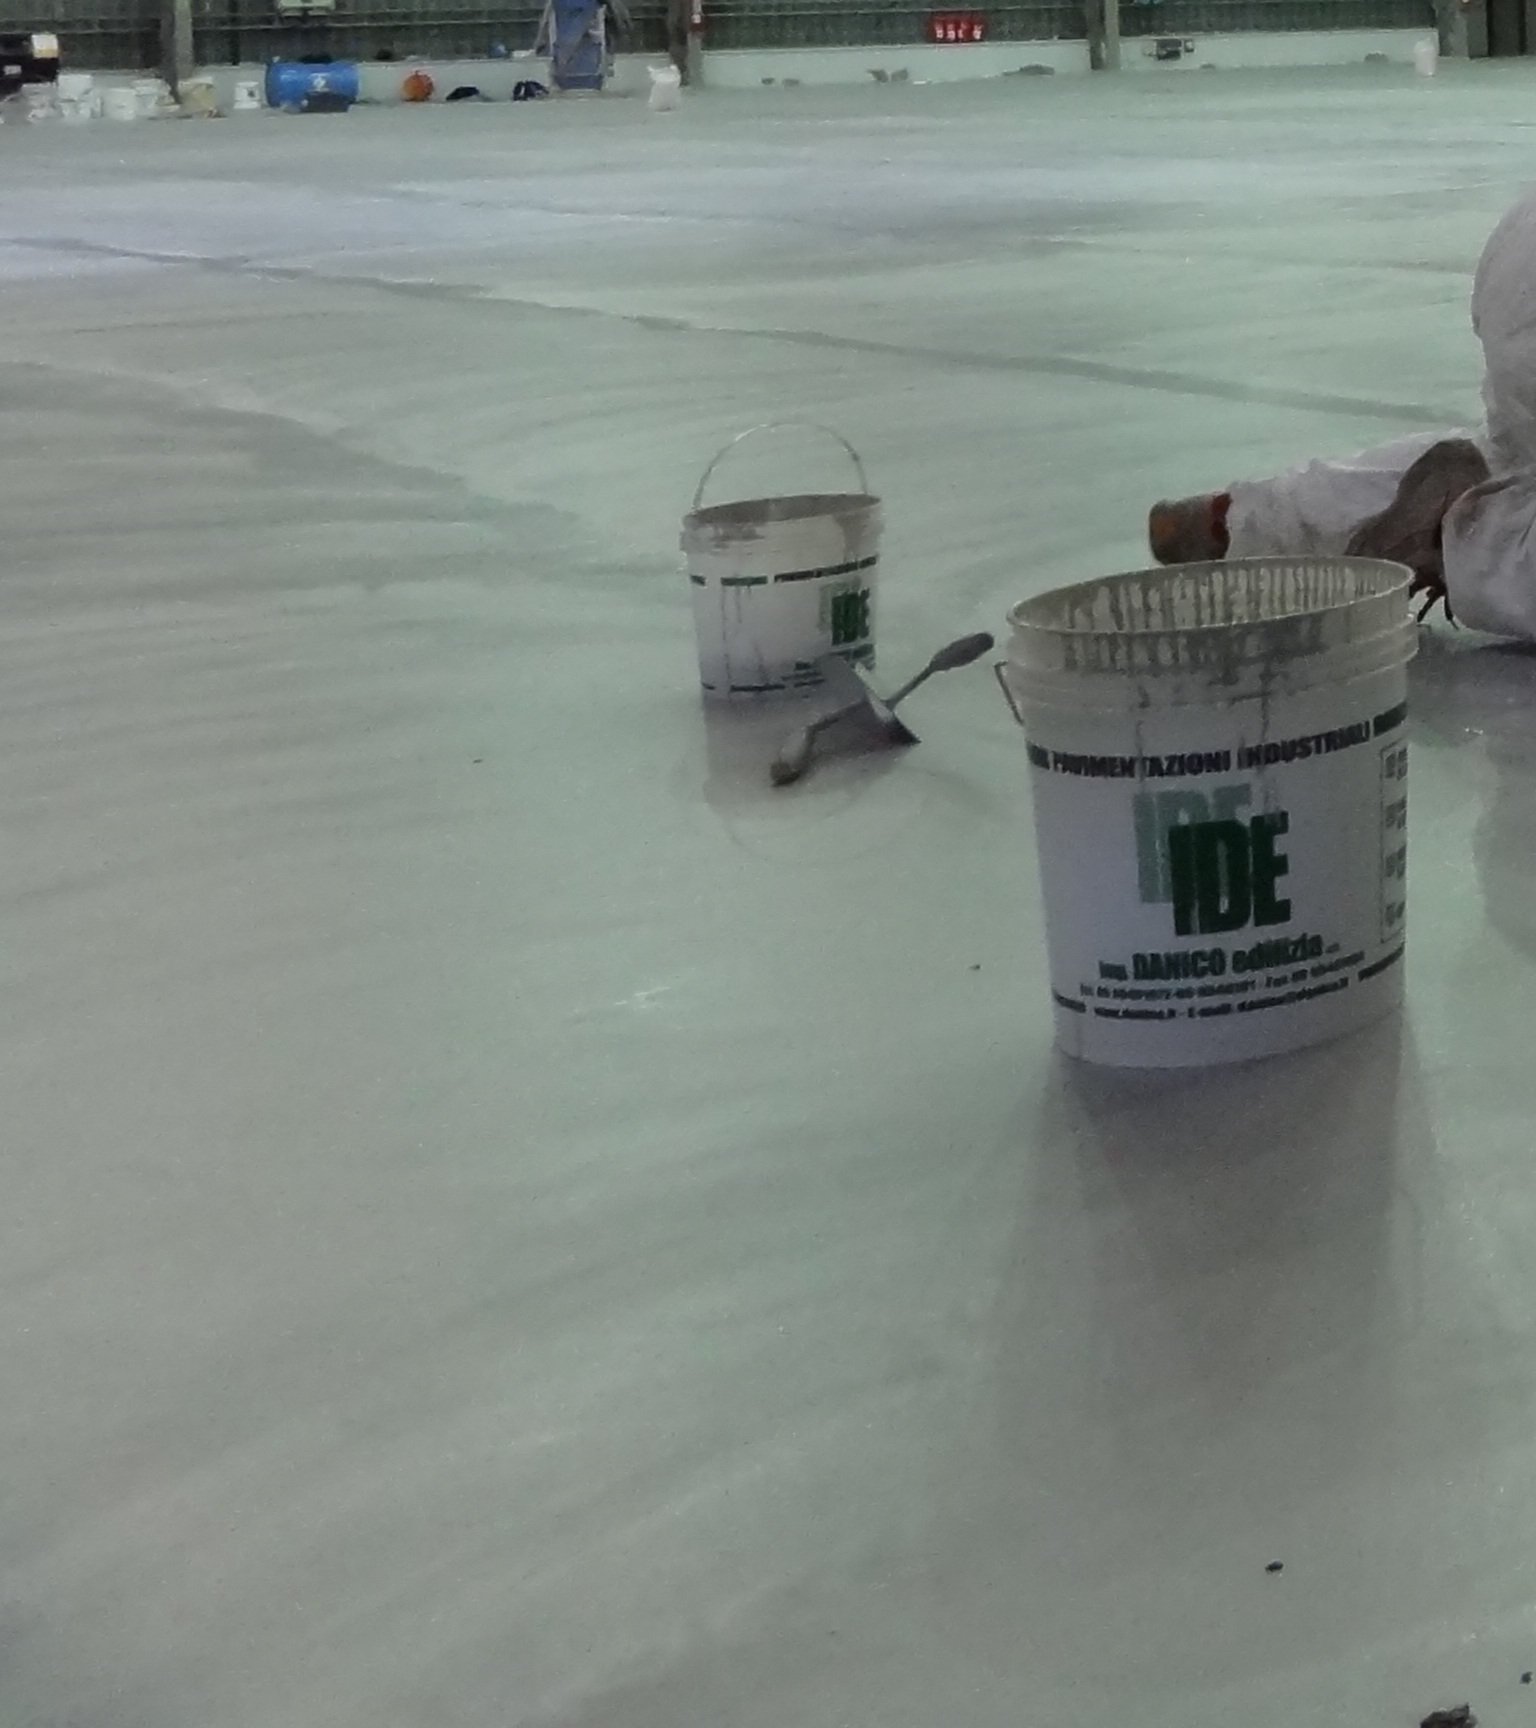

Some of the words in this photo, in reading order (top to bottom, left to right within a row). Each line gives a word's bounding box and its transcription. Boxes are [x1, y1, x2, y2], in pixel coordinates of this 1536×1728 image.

[1052, 749, 1232, 779] PAVIMENTAZIONI
[1168, 811, 1291, 935] IDE
[1132, 948, 1227, 980] DANICO
